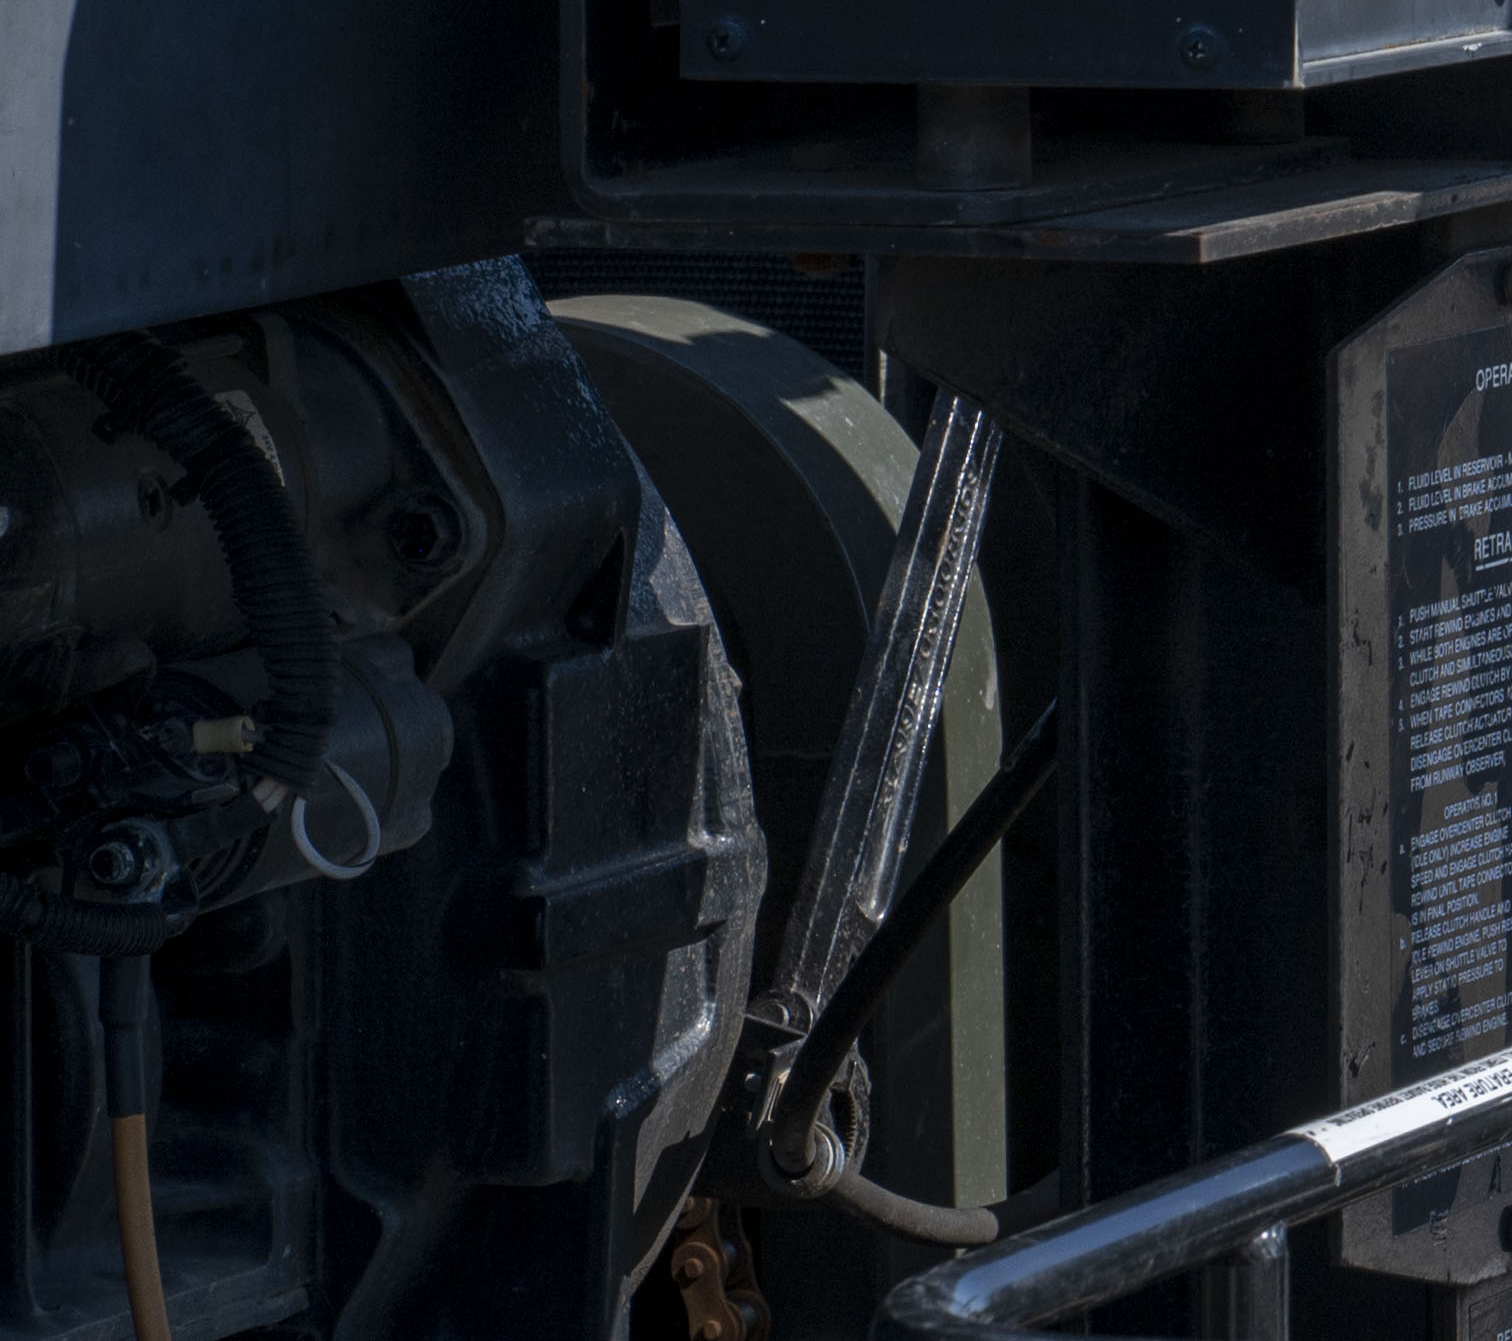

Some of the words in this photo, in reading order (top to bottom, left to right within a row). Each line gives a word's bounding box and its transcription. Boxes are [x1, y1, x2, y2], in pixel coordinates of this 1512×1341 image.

[1408, 473, 1429, 490] FLUID
[1430, 467, 1451, 485] LEVEL
[1462, 454, 1502, 476] RESERVOIR
[1408, 493, 1429, 511] FLUID
[1431, 487, 1452, 505] LEVEL
[1463, 479, 1485, 497] BRAKE
[1408, 510, 1447, 532] PRESSURE
[1409, 605, 1429, 622] PUSH
[1410, 626, 1432, 644] START
[1410, 647, 1432, 664] WHILE
[1455, 632, 1485, 652] ENGINES
[1487, 627, 1502, 642] ARE
[1410, 666, 1438, 686] CLUTCH
[1440, 661, 1454, 677] AND
[1441, 678, 1469, 698] REWIND
[1410, 710, 1431, 727] WHEN
[1434, 704, 1452, 720] TAPE
[1411, 745, 1453, 770] DISENGAGE
[1411, 773, 1432, 791] FROM
[1433, 763, 1464, 785] RUNWAY
[1439, 815, 1483, 841] OVERCENTER
[1450, 834, 1482, 856] INCREASE
[1411, 869, 1432, 888] SPEED
[1434, 864, 1448, 880] AND
[1449, 855, 1476, 875] ENGAGE
[1411, 886, 1437, 906] REWIND
[1459, 874, 1475, 890] TAPE
[1428, 903, 1445, 919] FINAL
[1470, 904, 1496, 925] HANDLE
[1497, 899, 1510, 915] AND
